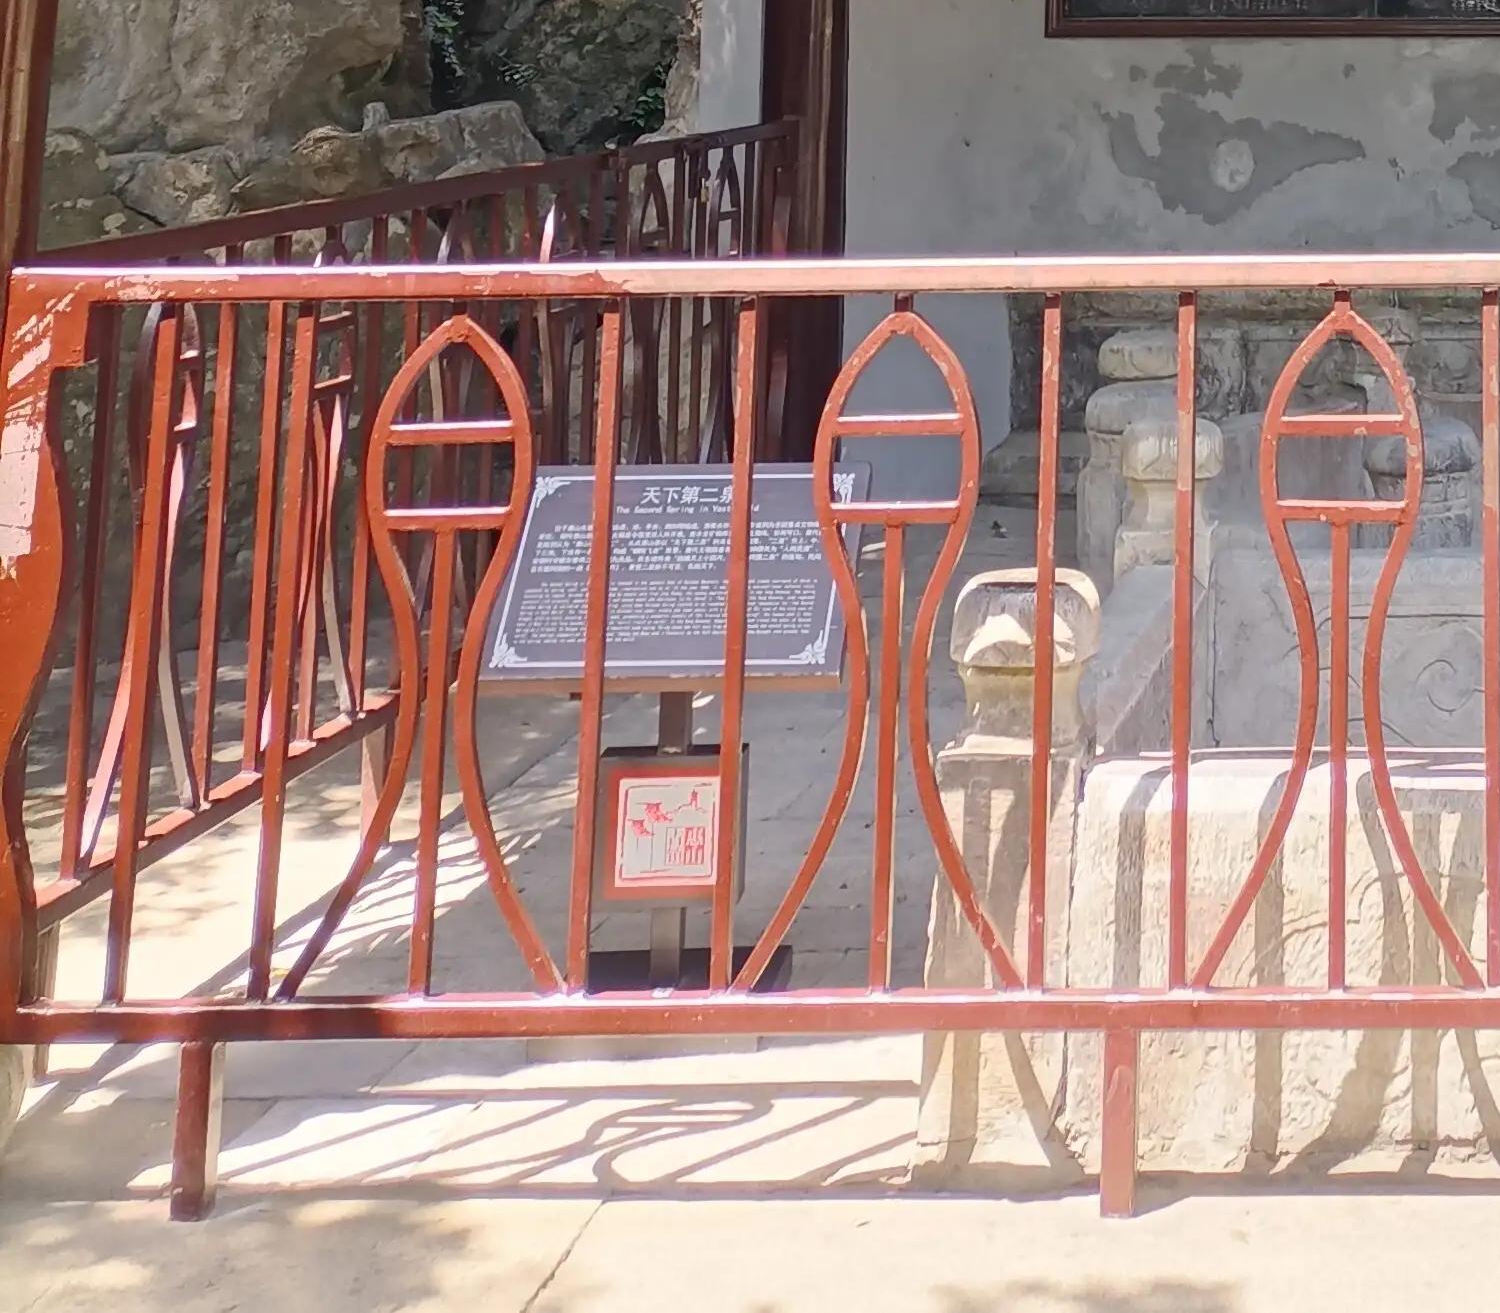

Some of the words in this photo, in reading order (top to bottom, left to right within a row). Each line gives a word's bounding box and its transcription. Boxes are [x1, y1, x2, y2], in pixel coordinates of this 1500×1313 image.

[641, 485, 733, 504] 天下第二泉
